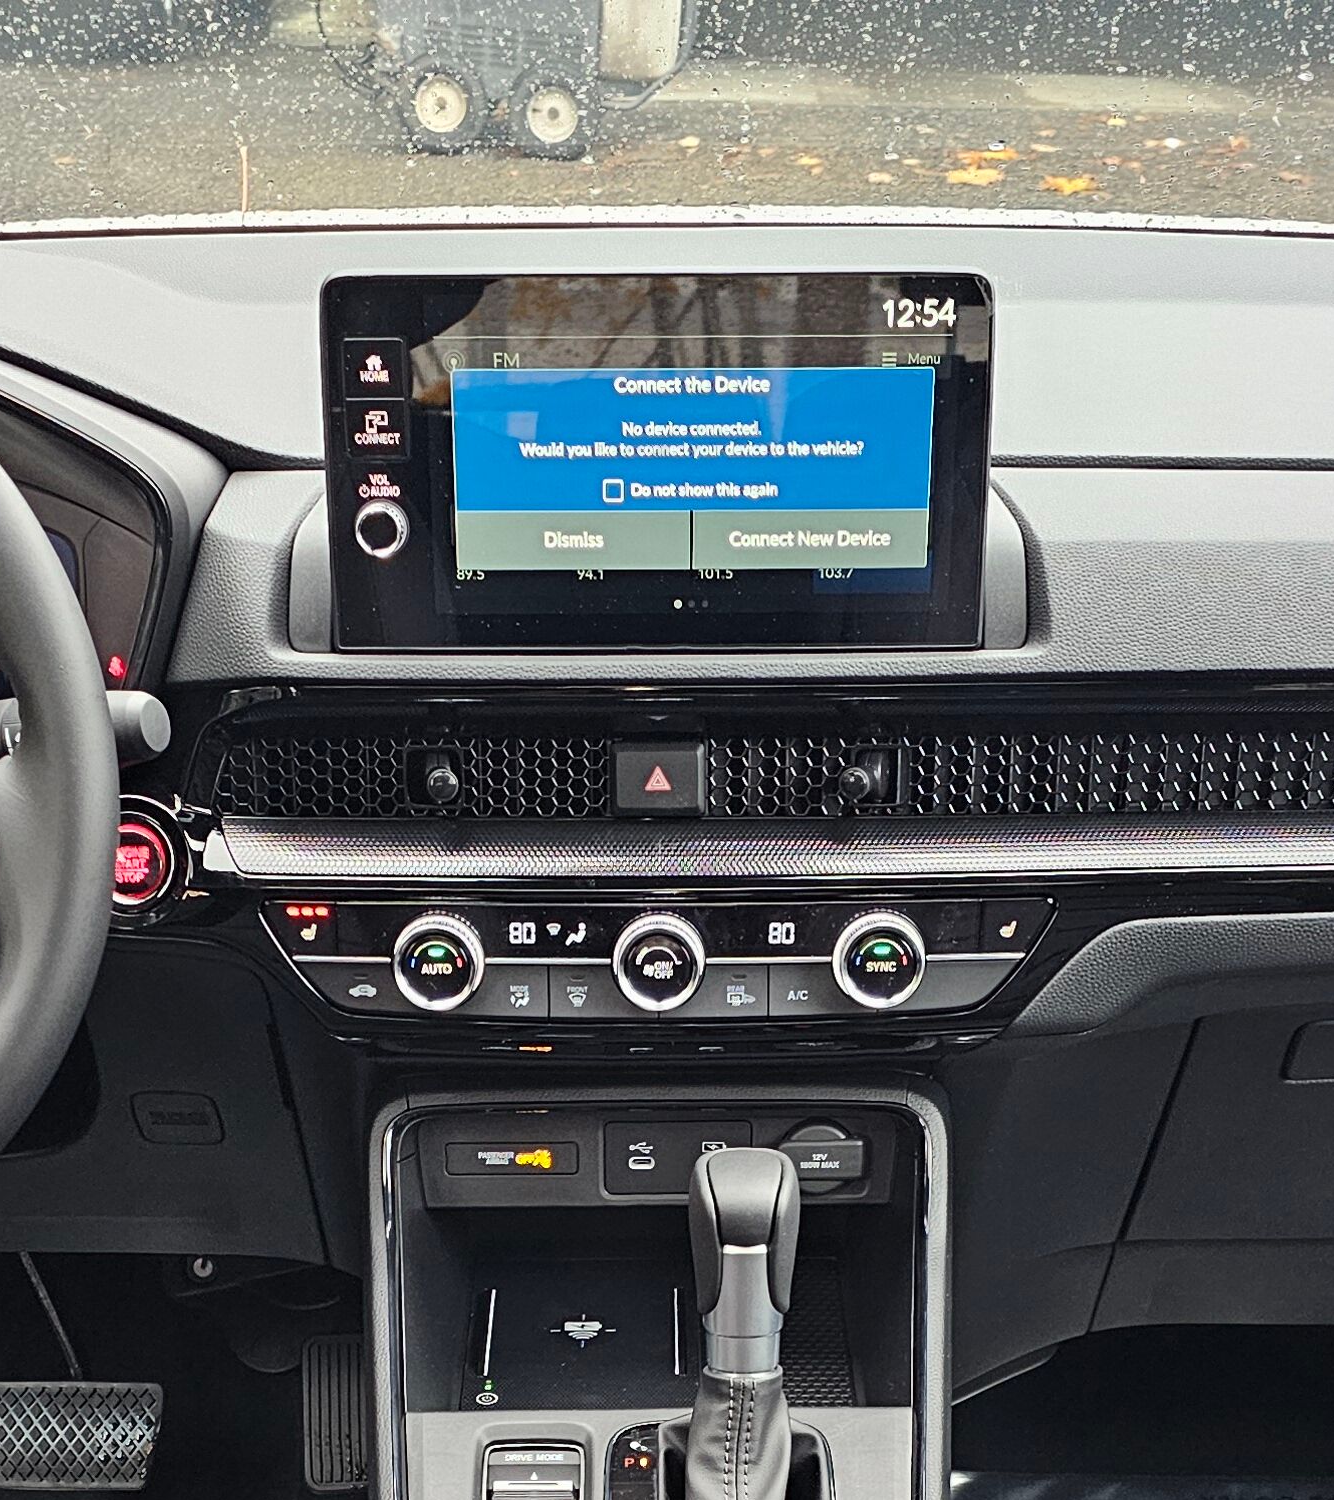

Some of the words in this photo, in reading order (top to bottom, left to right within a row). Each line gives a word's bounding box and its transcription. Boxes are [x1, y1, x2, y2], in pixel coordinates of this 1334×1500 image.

[883, 297, 957, 328] 12:54
[493, 353, 520, 369] FM
[907, 352, 941, 365] Menu
[359, 370, 389, 383] HOME
[614, 376, 681, 394] Connect
[684, 376, 711, 393] the
[714, 375, 771, 393] Device
[622, 421, 640, 437] No
[644, 421, 688, 437] device
[689, 420, 762, 436] connected.
[354, 432, 401, 445] CONNECT
[519, 442, 565, 458] Would
[566, 445, 592, 459] you
[594, 442, 618, 457] like
[619, 443, 634, 457] to
[636, 443, 690, 457] connect
[693, 443, 724, 459] your
[724, 440, 767, 456] device
[769, 442, 785, 456] to
[787, 441, 811, 456] the
[811, 440, 865, 456] vehicle?
[368, 474, 390, 486] VOL
[370, 485, 400, 498] AUDIO
[630, 482, 652, 497] Do
[653, 484, 677, 497] not
[677, 482, 714, 498] show
[715, 482, 740, 497] this
[742, 481, 779, 499] again
[544, 531, 604, 548] Dismiss
[728, 530, 795, 547] Connect
[796, 530, 834, 547] New
[836, 529, 892, 547] Device
[455, 568, 486, 581] 89.5
[576, 568, 605, 581] 94.1
[697, 568, 734, 580] 101.5
[817, 567, 854, 580] 103.7
[508, 921, 537, 945] 80
[767, 921, 796, 945] 80
[421, 963, 453, 976] AUTO
[866, 961, 897, 974] SYNC
[566, 985, 589, 994] FRONT
[786, 990, 809, 1001] A/C
[812, 1153, 828, 1161] 12V
[821, 1161, 841, 1169] MAX
[504, 1453, 533, 1462] DRIVE
[535, 1453, 564, 1462] MODE
[624, 1457, 635, 1468] P
